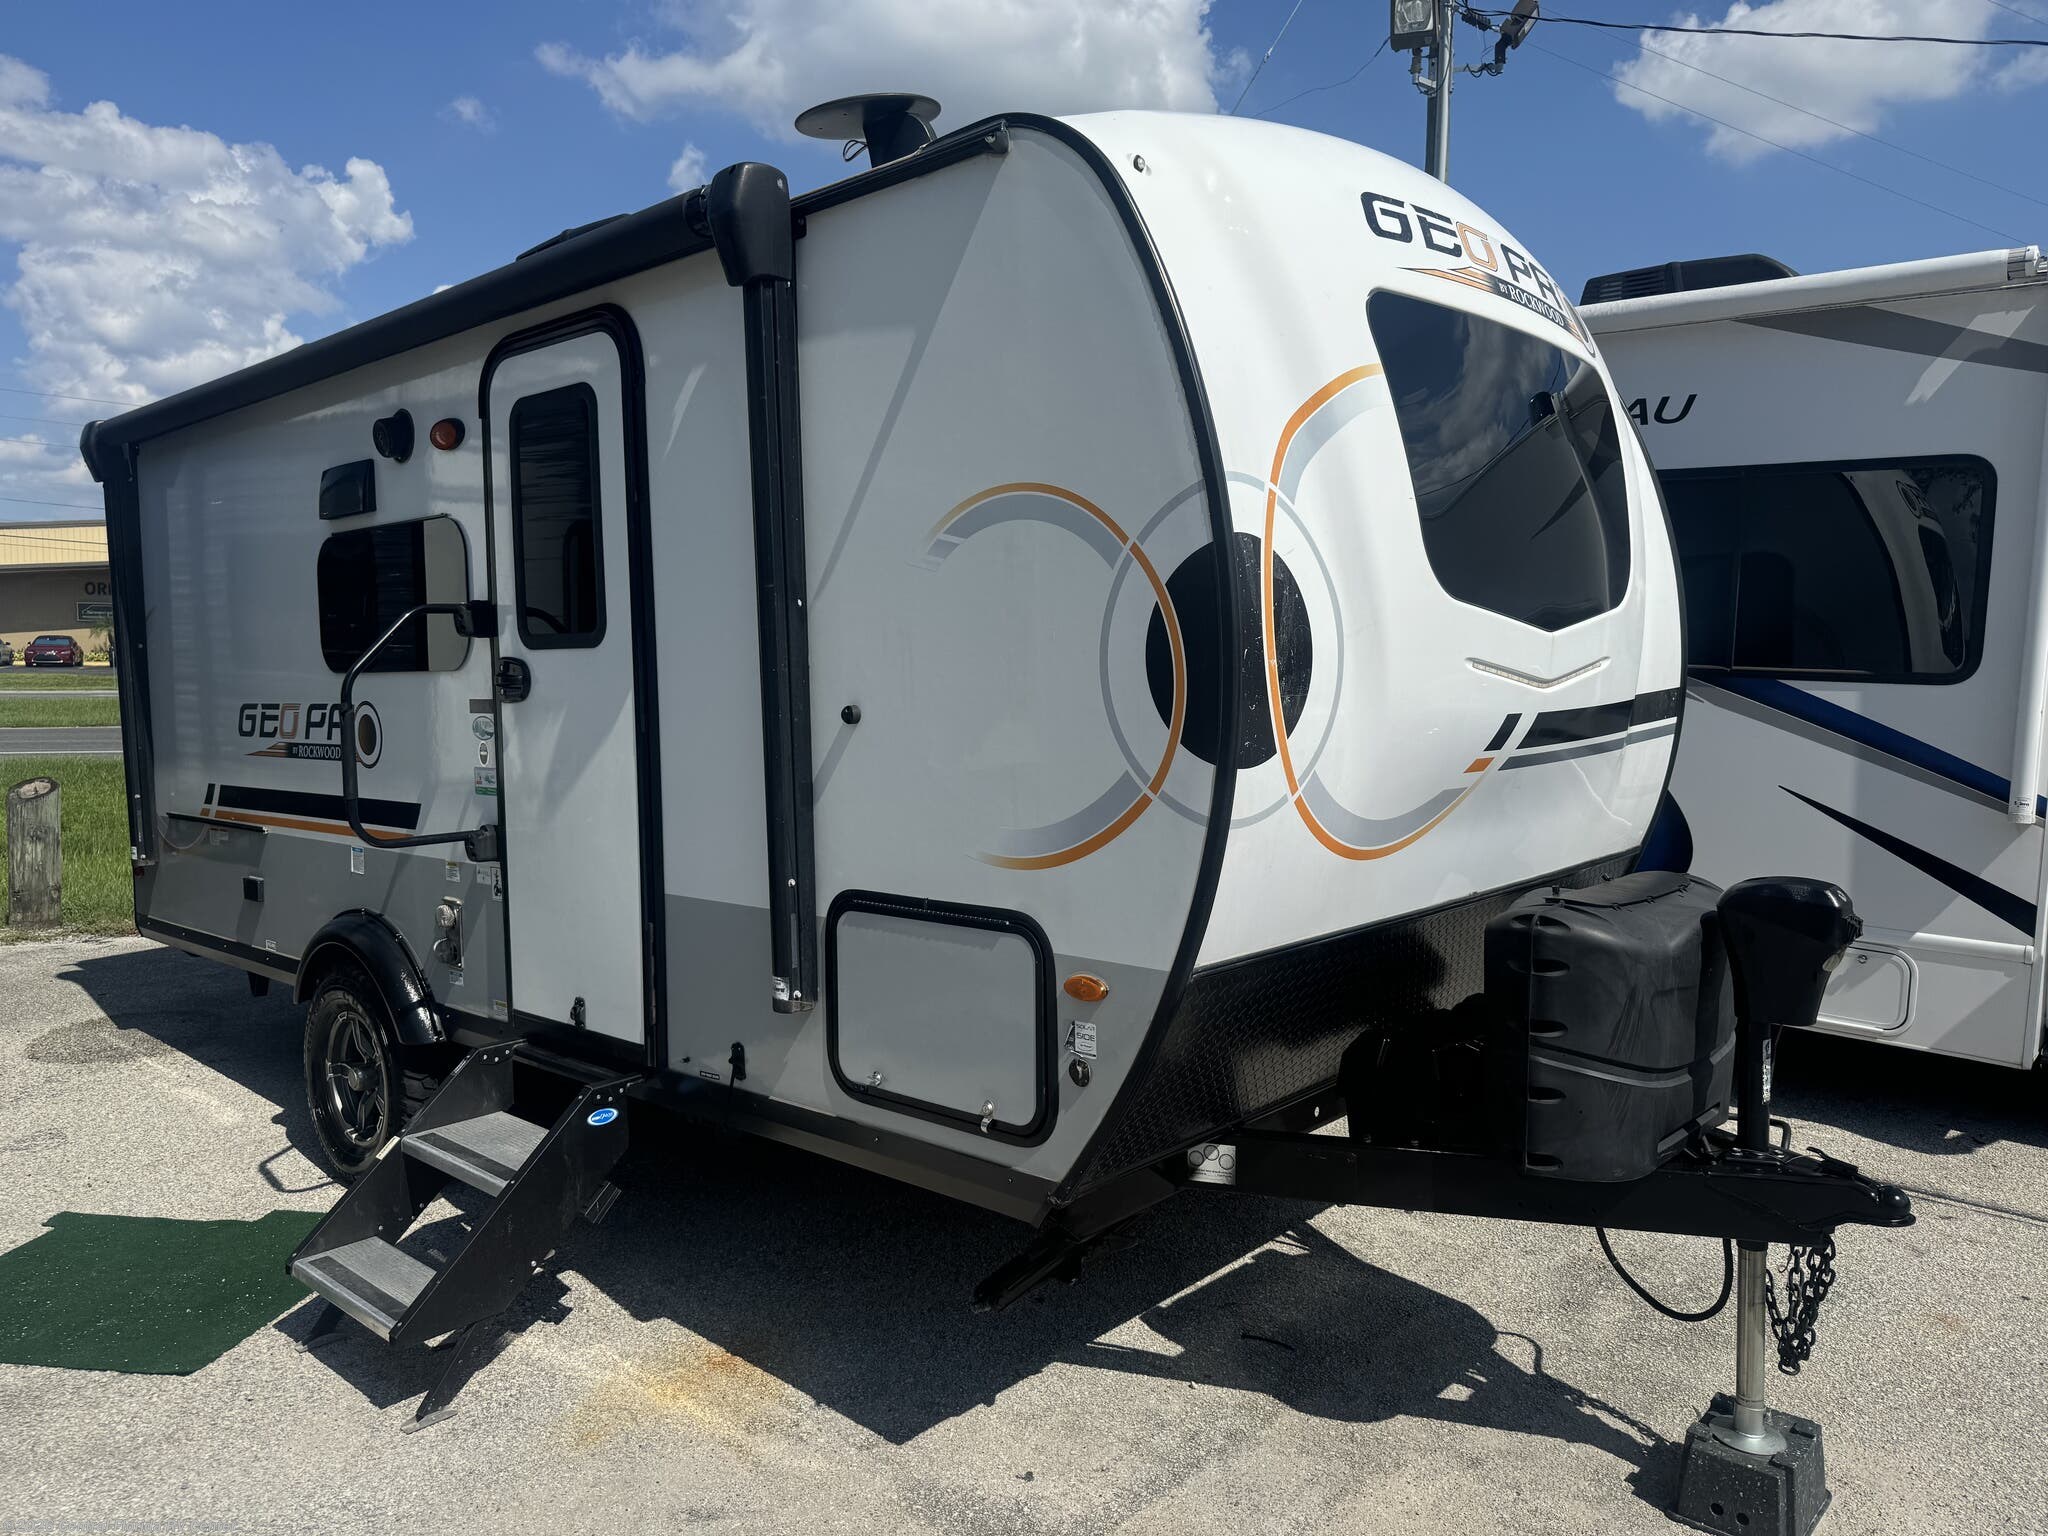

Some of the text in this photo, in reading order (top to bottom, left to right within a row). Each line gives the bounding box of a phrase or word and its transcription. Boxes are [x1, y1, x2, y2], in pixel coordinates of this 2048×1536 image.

[1360, 191, 1498, 272] GEO
[1499, 282, 1565, 327] BY ROCKWOOD
[238, 703, 301, 740] GEO
[298, 745, 341, 759] ROCKWOOD
